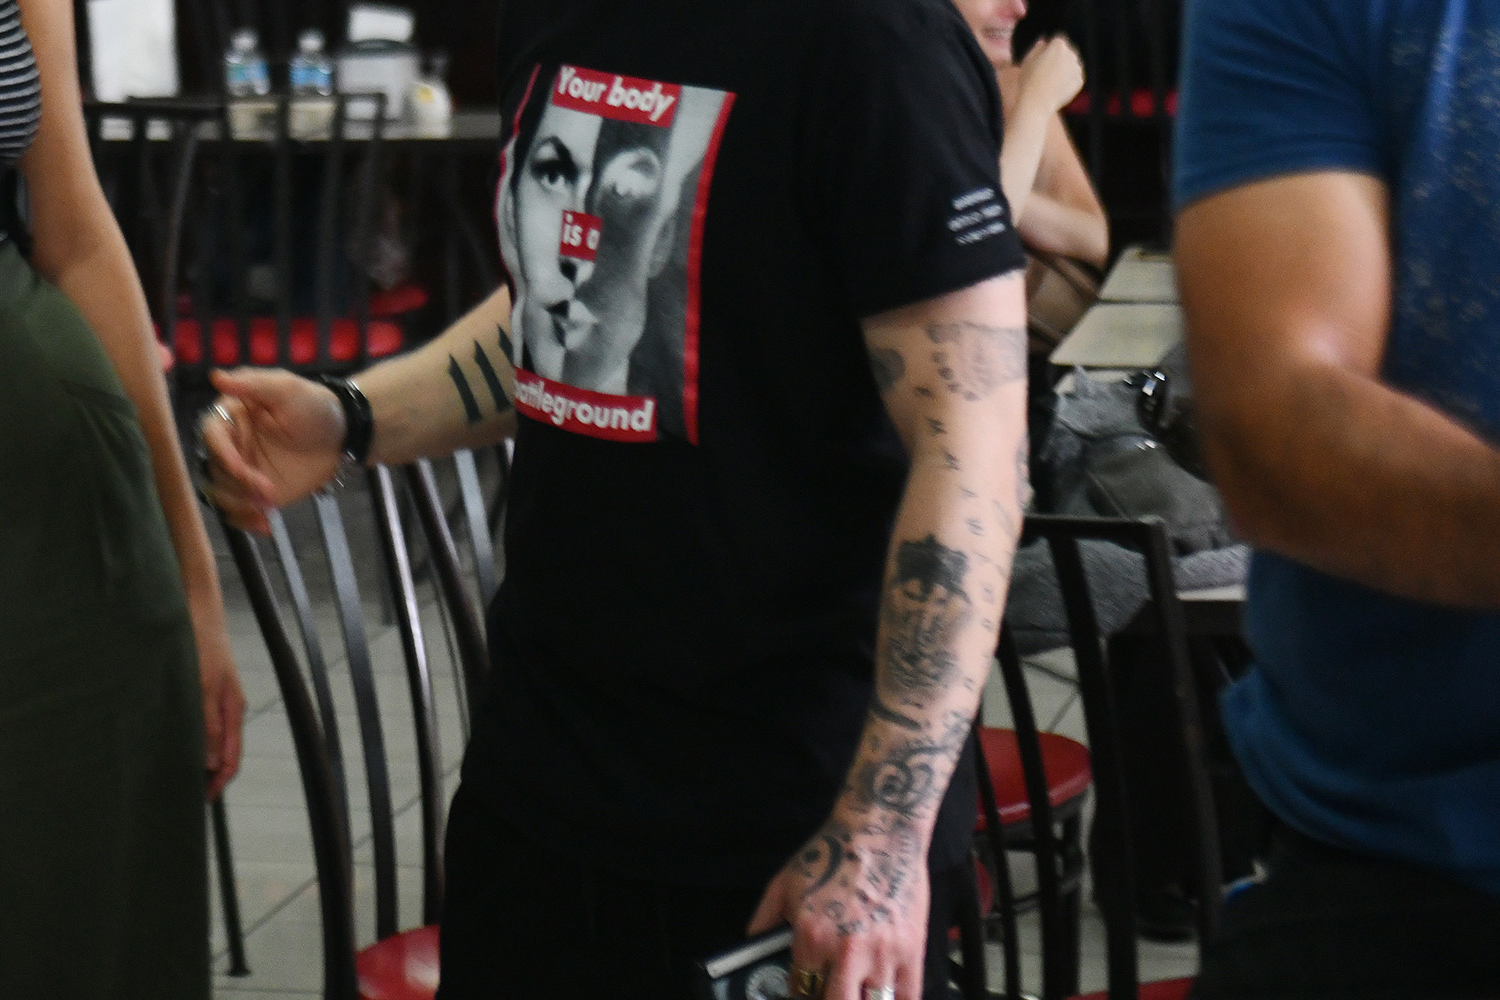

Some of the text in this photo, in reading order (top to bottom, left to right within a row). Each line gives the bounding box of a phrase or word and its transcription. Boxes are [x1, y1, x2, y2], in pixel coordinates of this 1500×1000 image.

[558, 65, 675, 122] Your body
[563, 213, 583, 247] is
